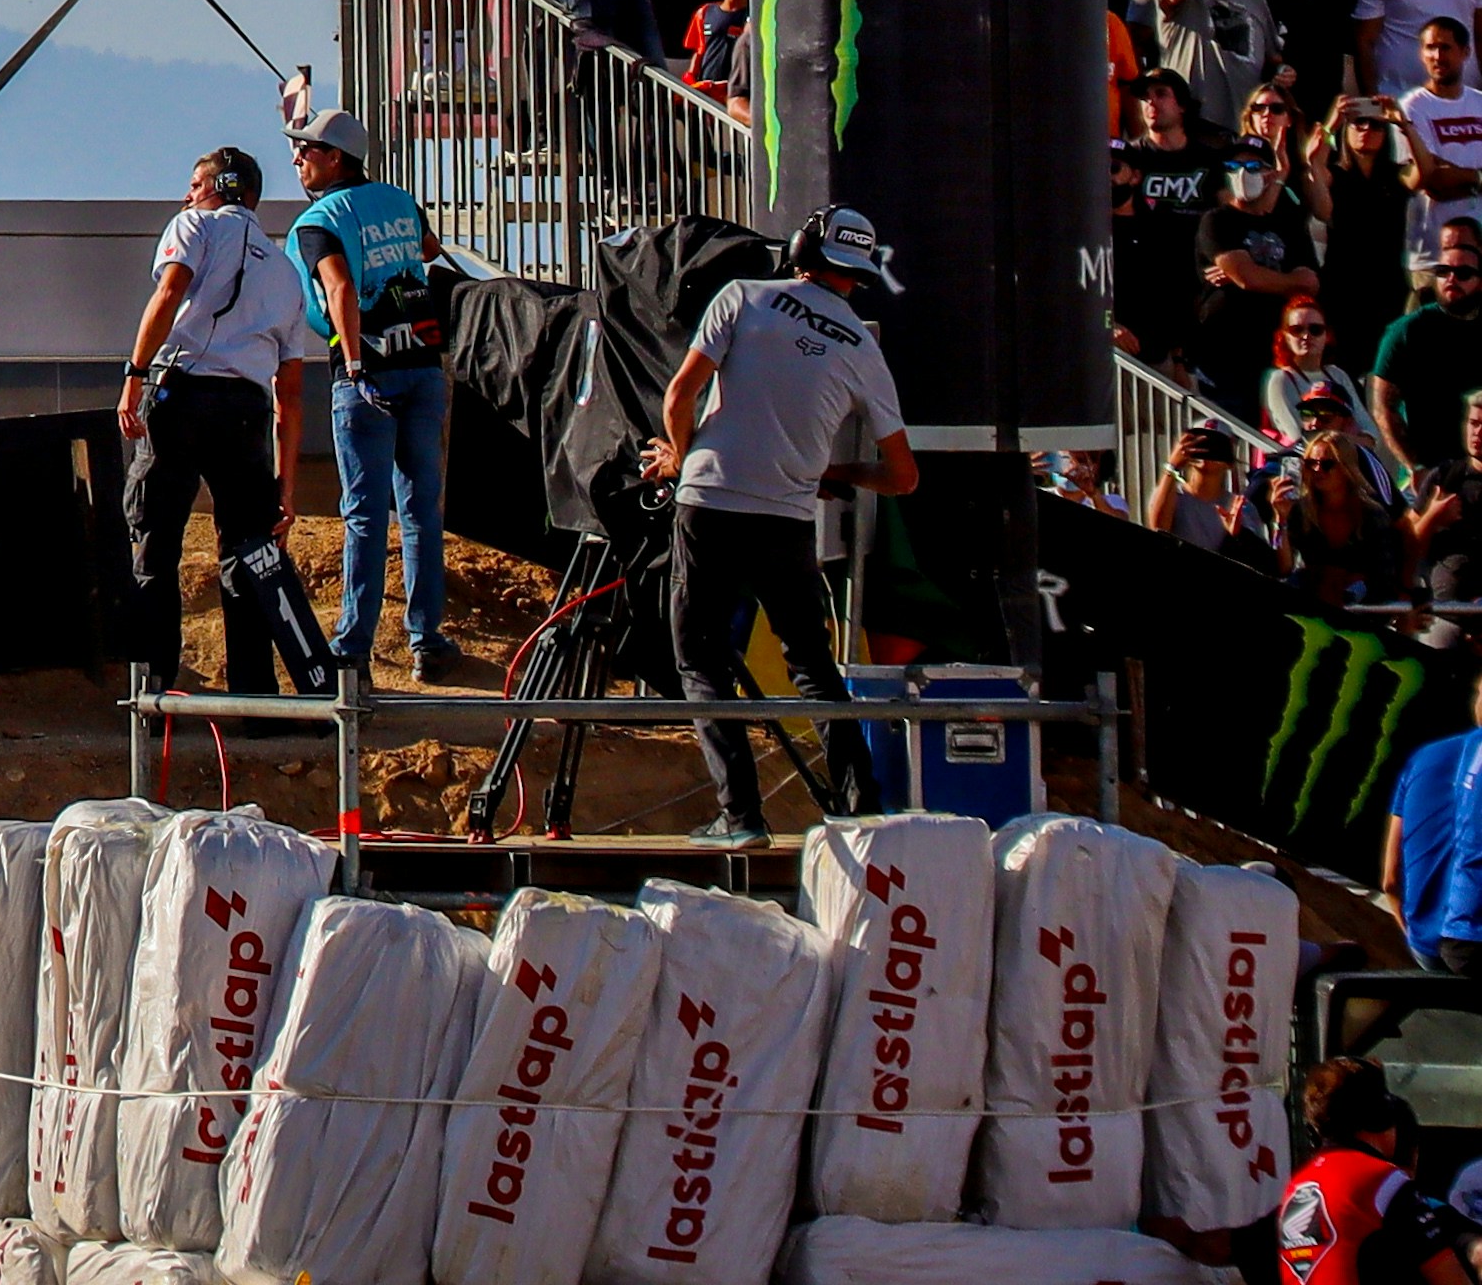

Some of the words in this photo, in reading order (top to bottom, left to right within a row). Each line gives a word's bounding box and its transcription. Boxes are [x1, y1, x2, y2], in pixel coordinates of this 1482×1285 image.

[1146, 172, 1204, 203] GMX
[767, 292, 862, 347] MXGP
[277, 586, 312, 659] 1
[467, 1005, 575, 1225] lastlap
[855, 904, 937, 1134] lastlap
[1048, 963, 1108, 1184] lastlap
[1215, 931, 1267, 1151] lastlap
[647, 1041, 739, 1264] lastlap
